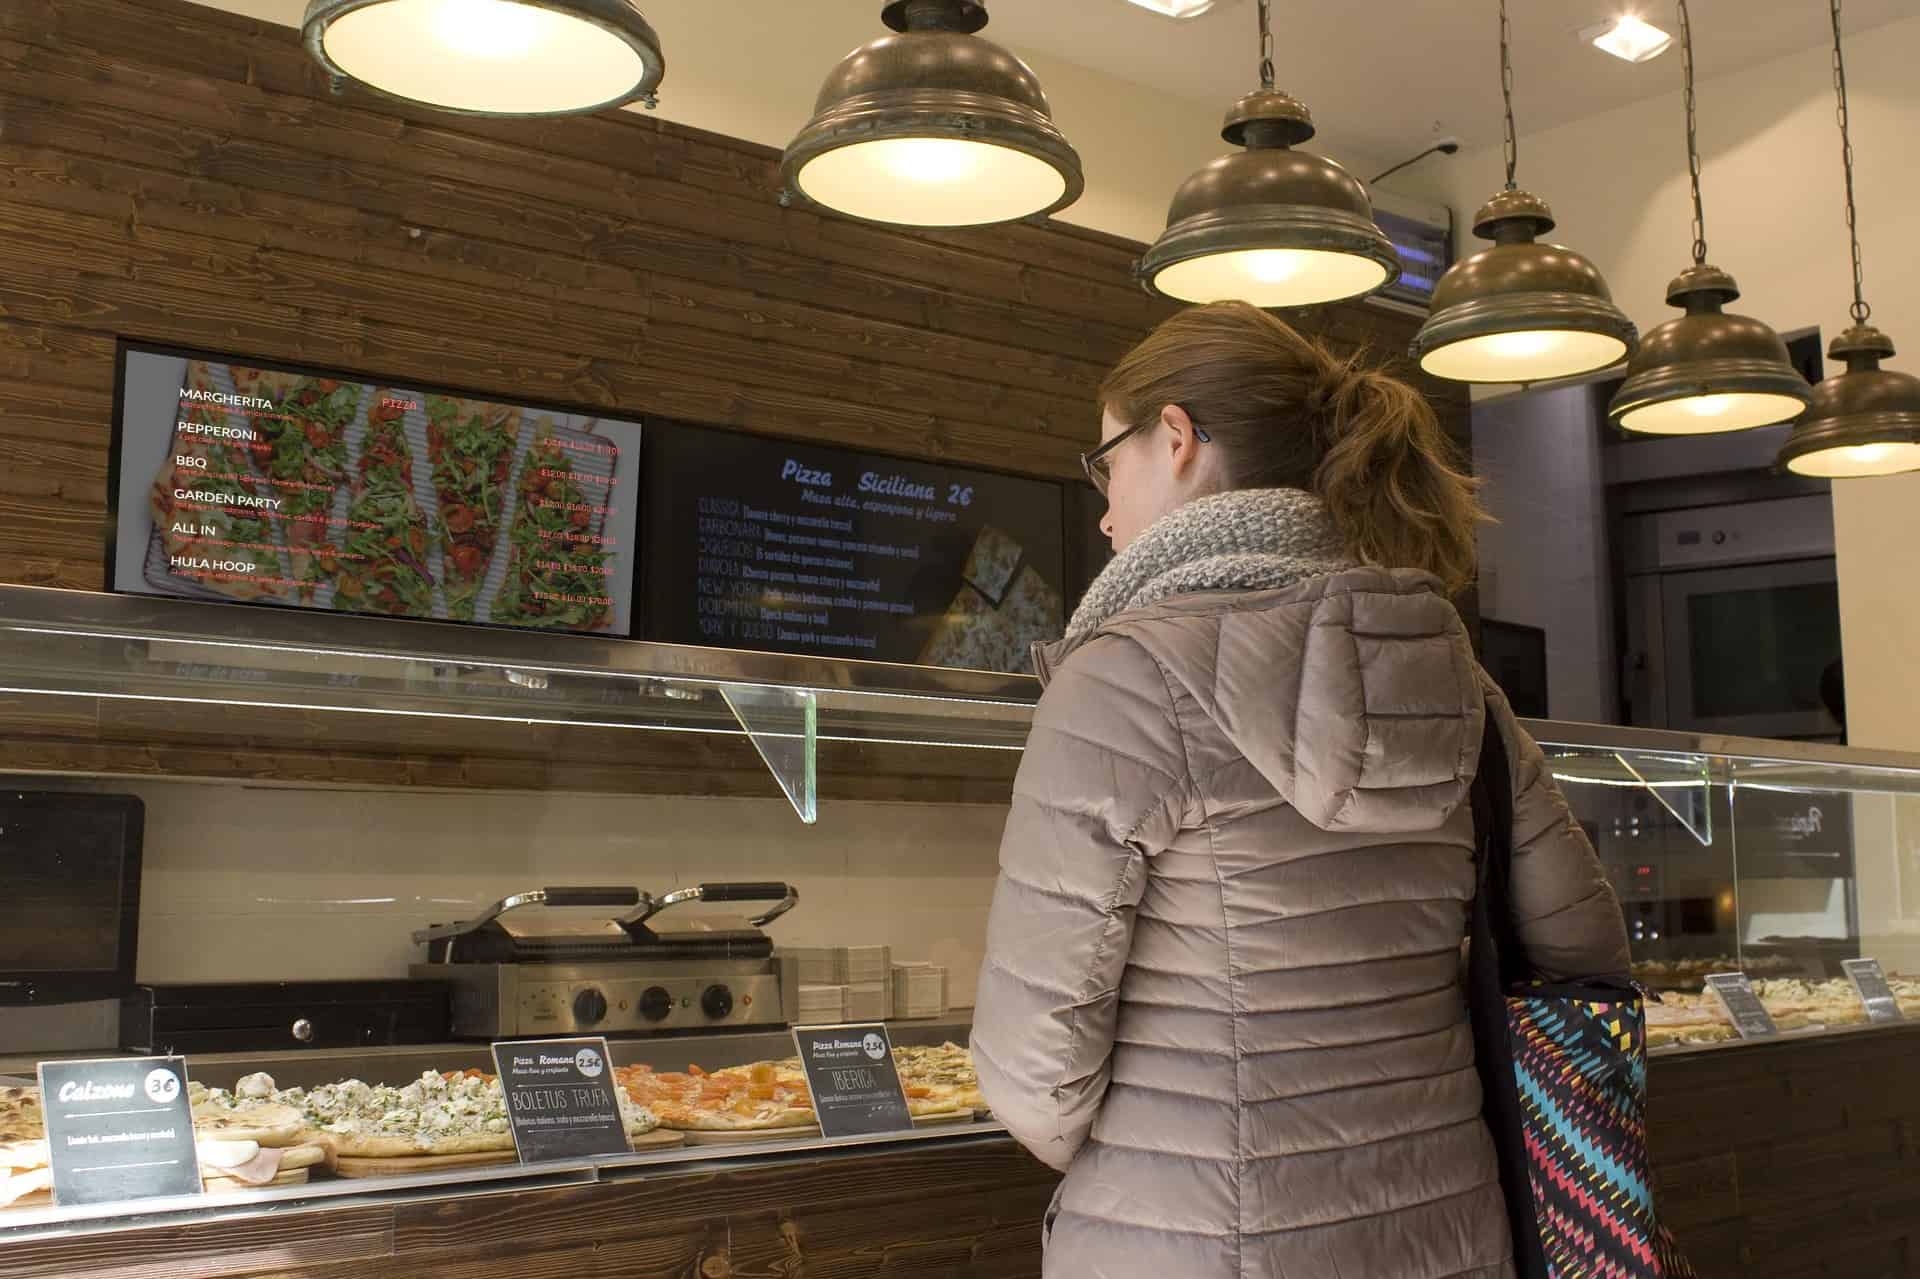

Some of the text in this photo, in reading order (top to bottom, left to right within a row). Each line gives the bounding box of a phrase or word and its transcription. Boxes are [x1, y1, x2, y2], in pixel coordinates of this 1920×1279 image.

[179, 388, 273, 410] MARGHERITA
[382, 398, 417, 410] PIZZA
[178, 421, 257, 441] PEPPERONI
[176, 455, 208, 470] BBQ
[782, 459, 974, 506] Pizza Siciliana 2€
[174, 488, 281, 511] GARDEN PARTY
[172, 522, 216, 537] ALL IN
[170, 555, 256, 574] HULA HOOP
[539, 1055, 574, 1065] Romana
[512, 1088, 609, 1110] BOLETUS TRUFA
